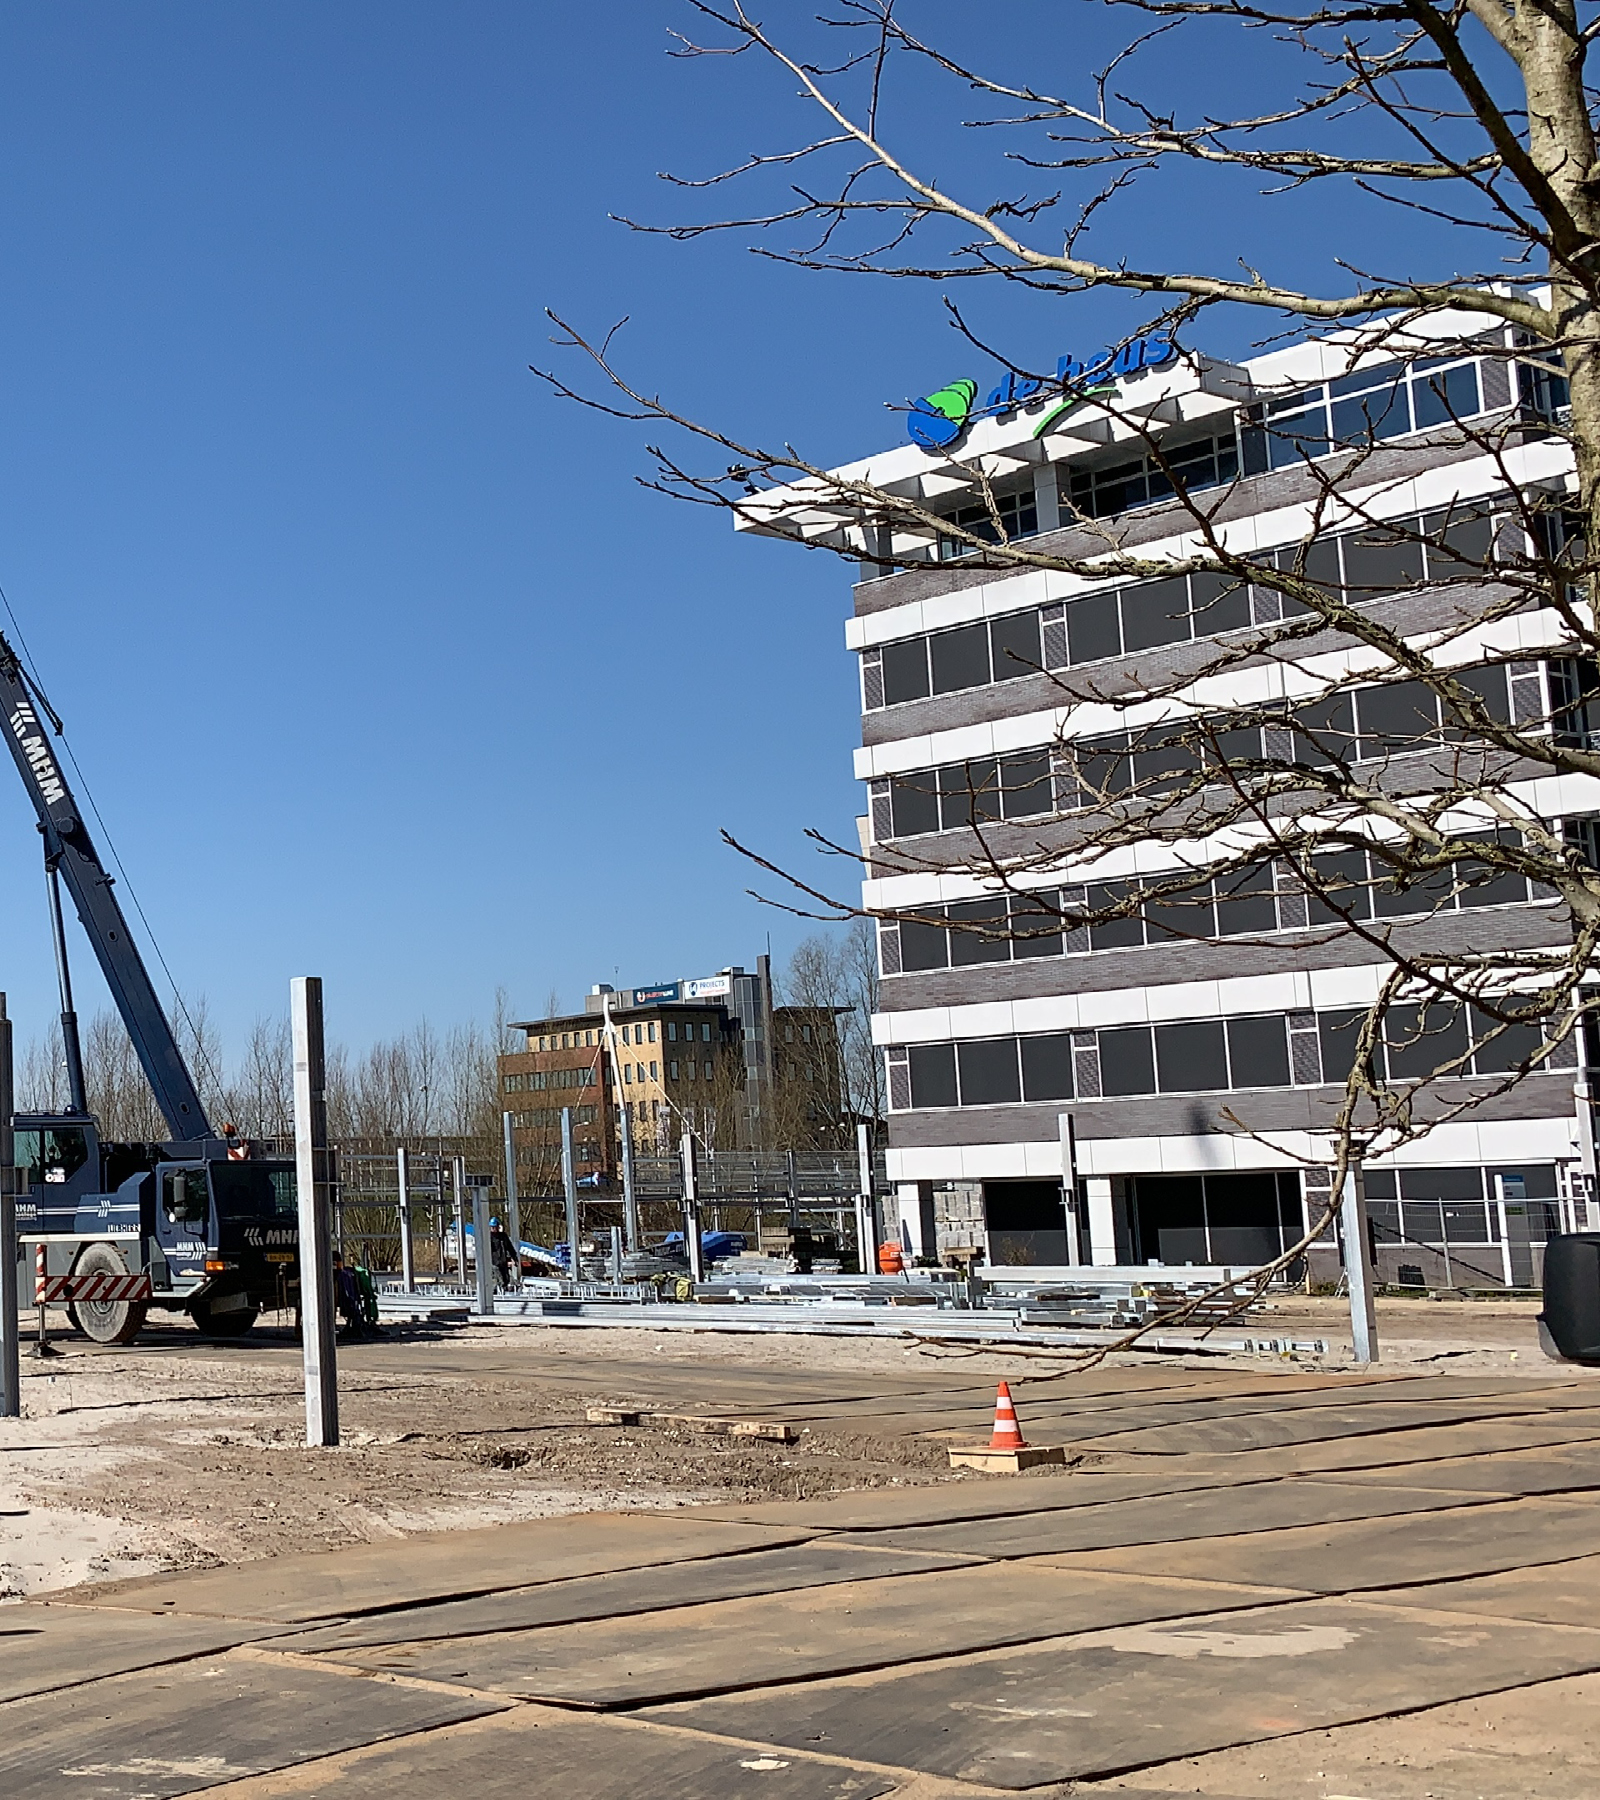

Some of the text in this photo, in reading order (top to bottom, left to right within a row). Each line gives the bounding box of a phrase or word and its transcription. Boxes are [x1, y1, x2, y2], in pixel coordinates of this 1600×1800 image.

[985, 331, 1173, 417] de heus
[21, 735, 65, 806] MHM
